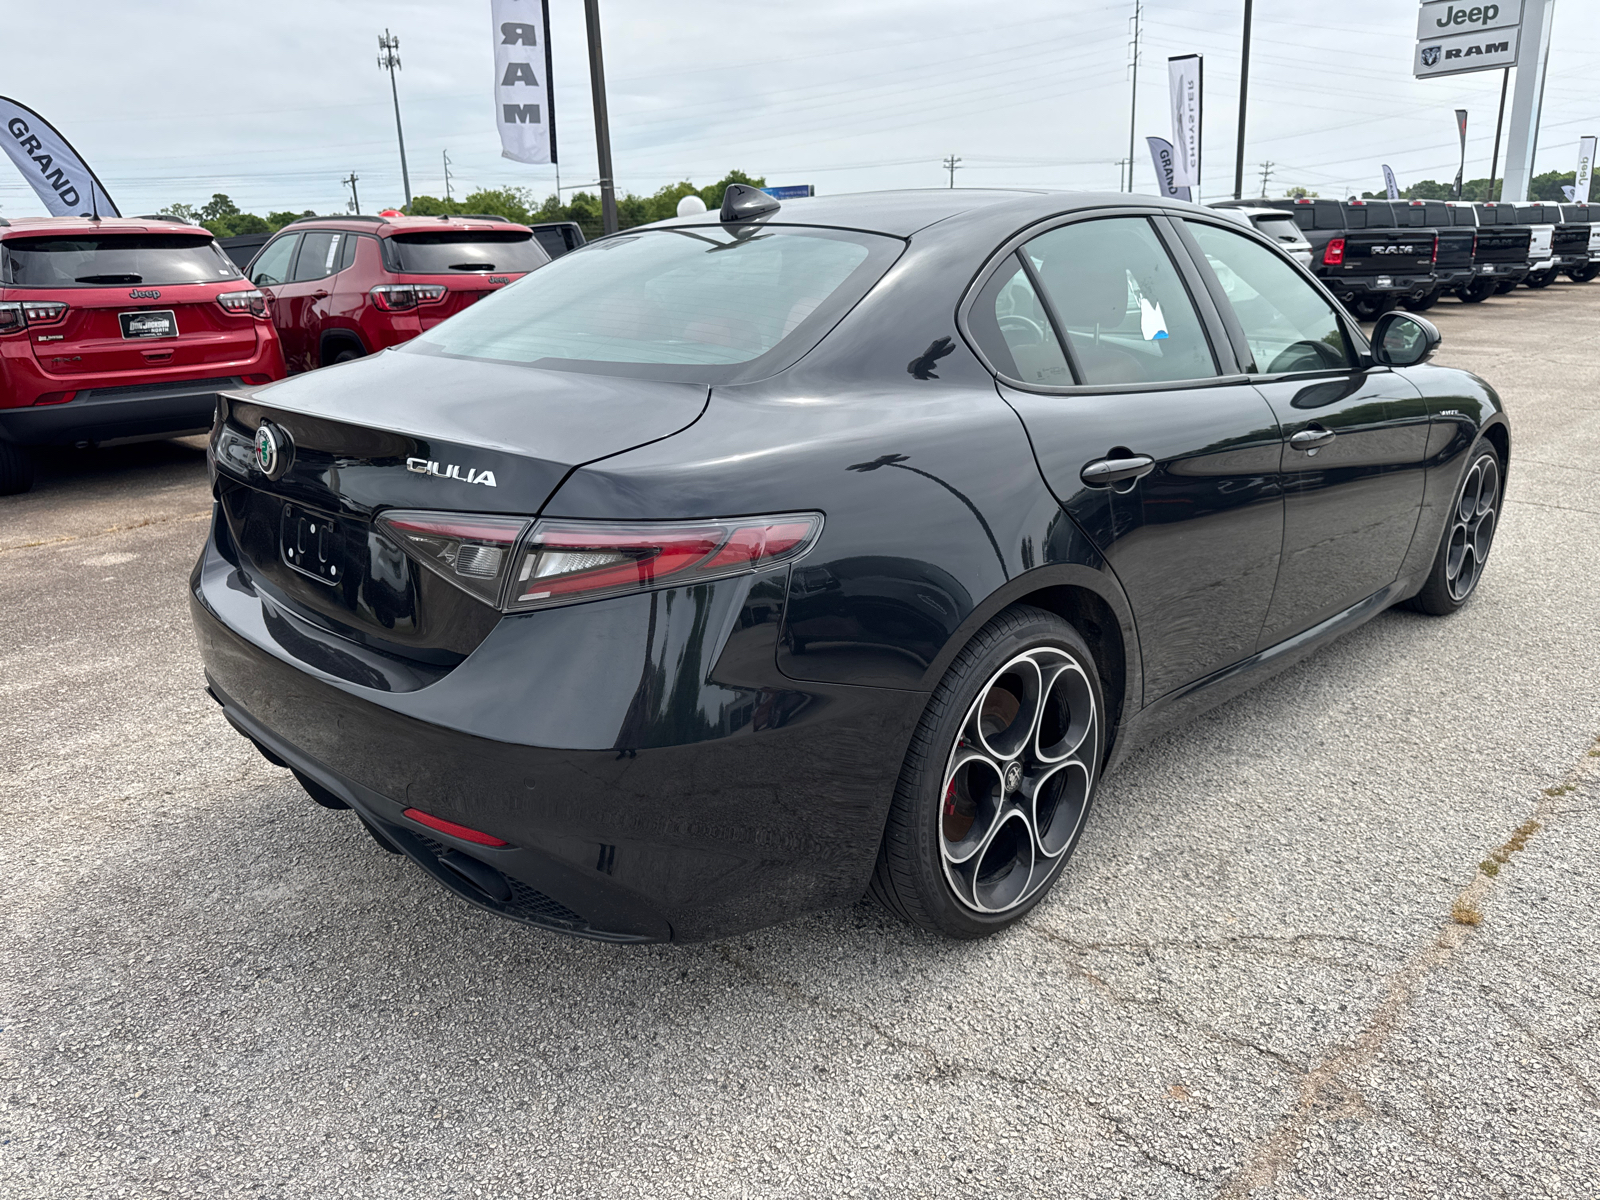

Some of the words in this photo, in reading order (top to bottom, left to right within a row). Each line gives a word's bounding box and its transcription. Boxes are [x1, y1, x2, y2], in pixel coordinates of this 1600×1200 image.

[1436, 3, 1499, 28] Jeep
[1445, 41, 1509, 60] RAM
[8, 117, 80, 207] GRAND
[1371, 245, 1414, 255] RAM
[488, 276, 510, 285] Jeep
[129, 289, 161, 299] Jeep
[406, 457, 497, 488] GIULIA
